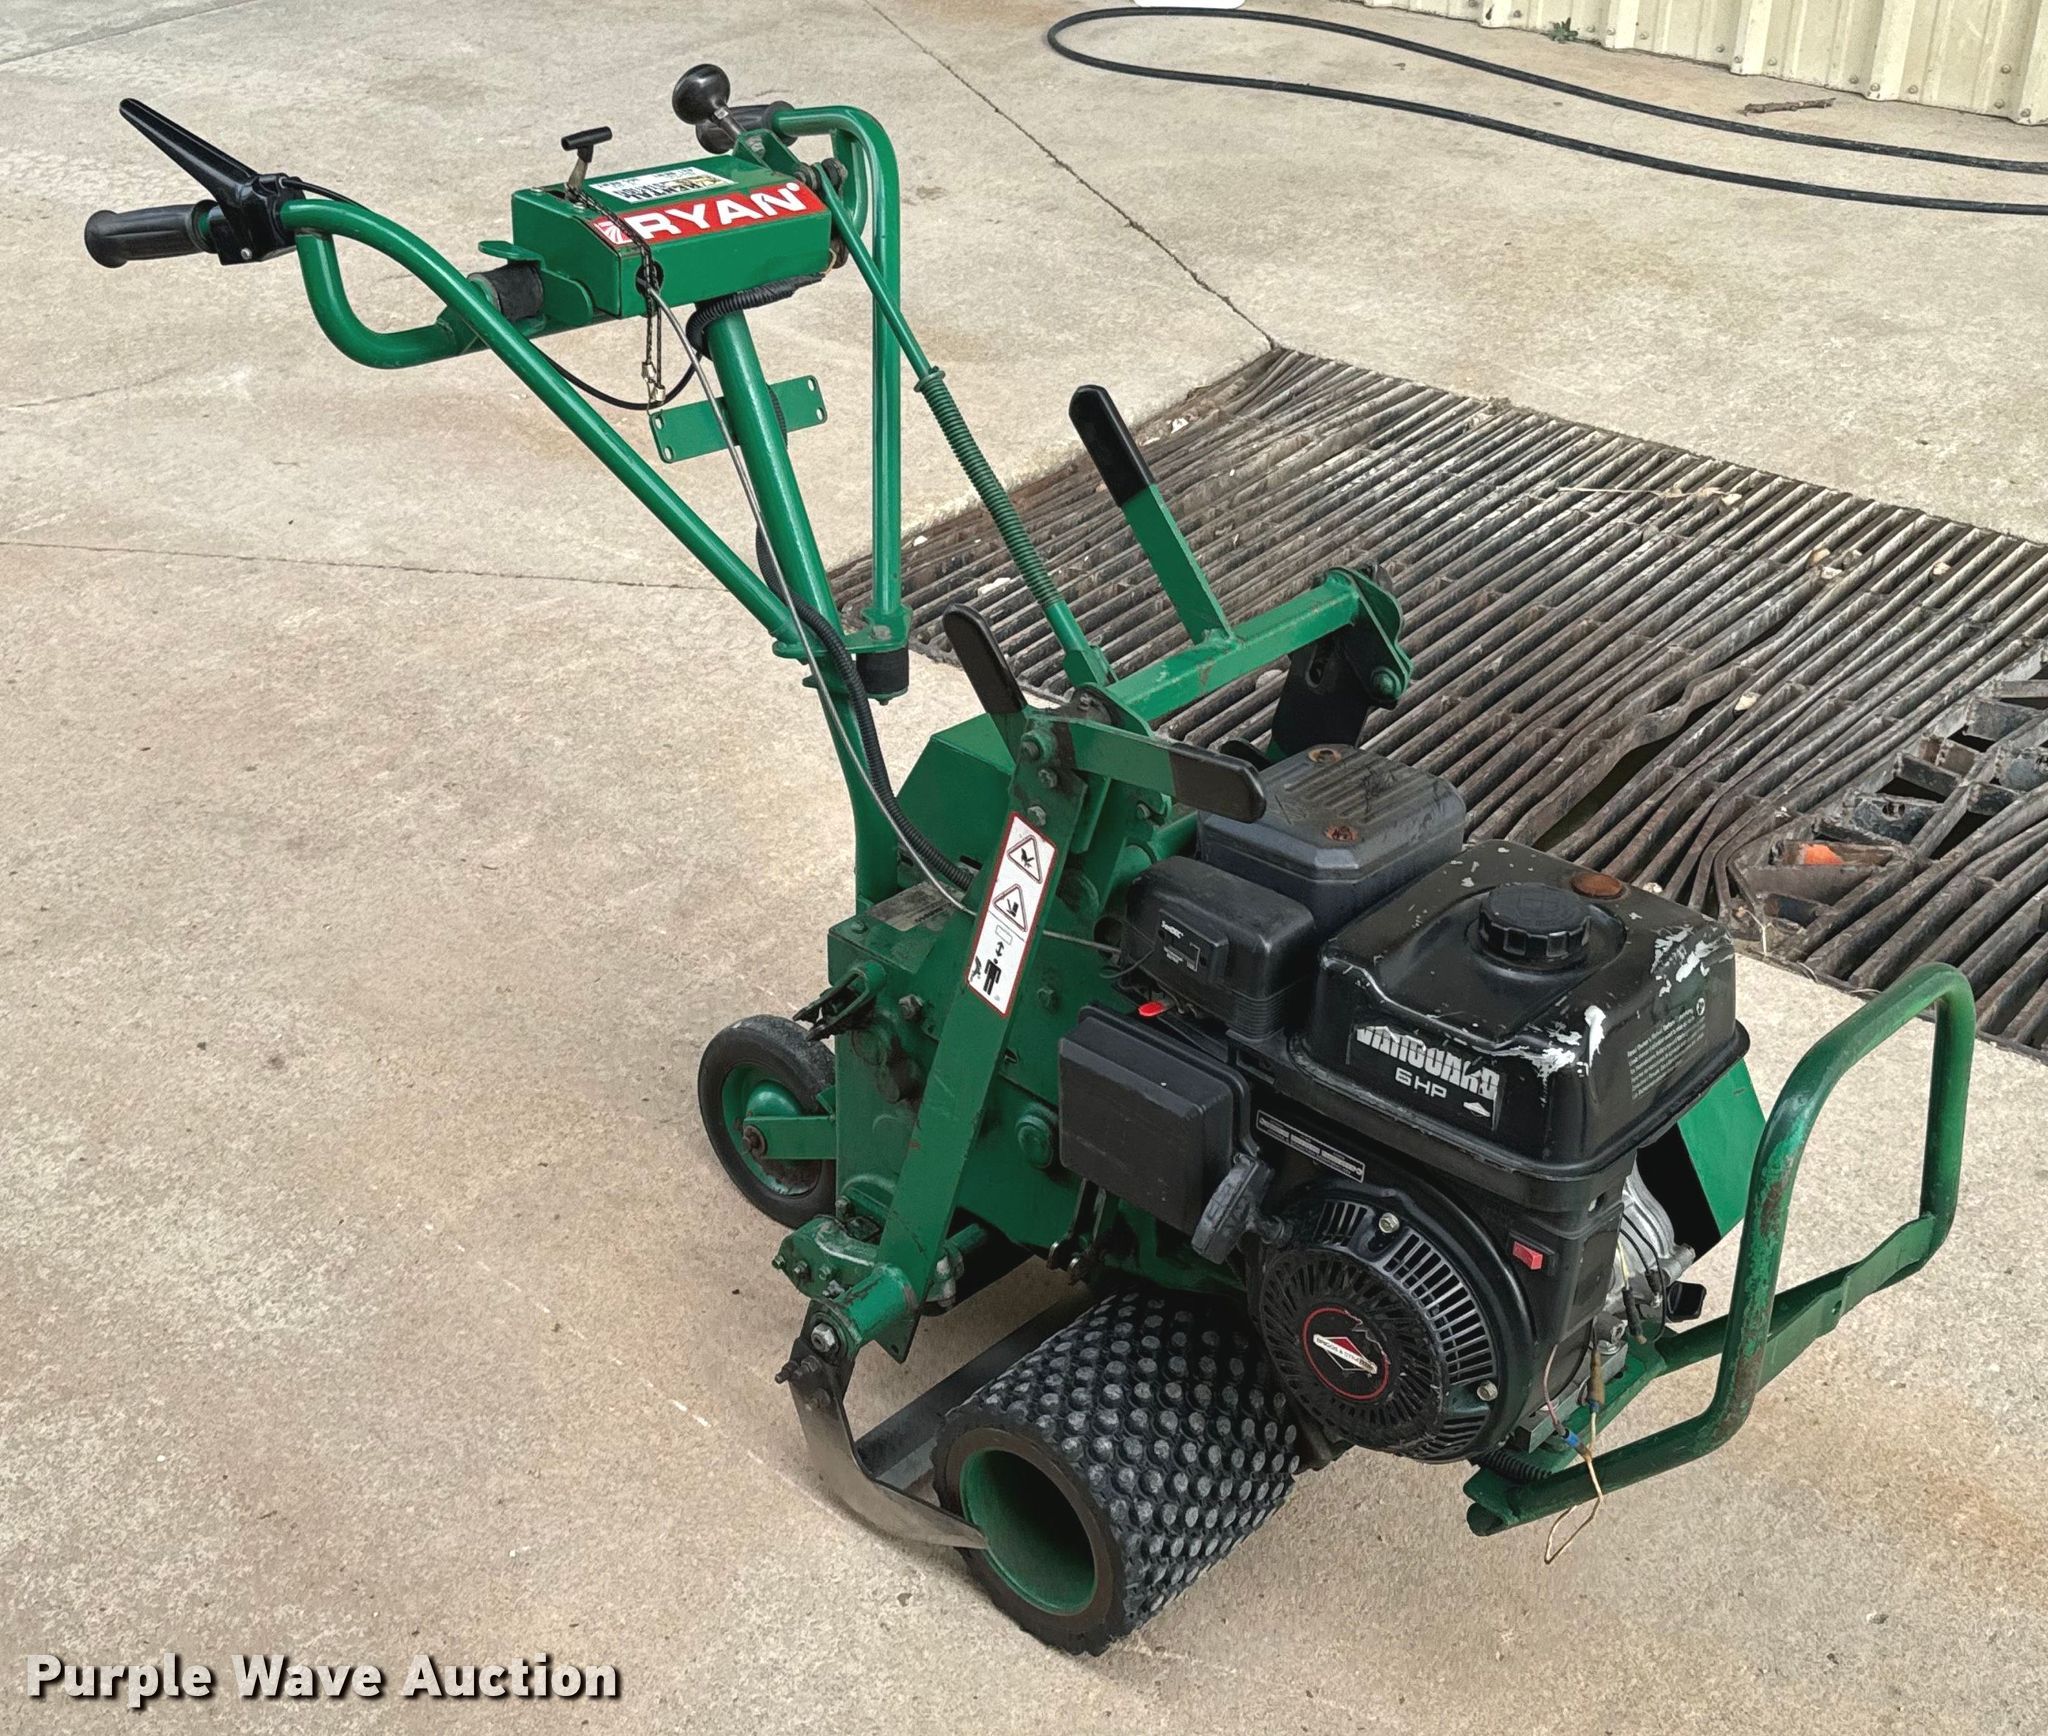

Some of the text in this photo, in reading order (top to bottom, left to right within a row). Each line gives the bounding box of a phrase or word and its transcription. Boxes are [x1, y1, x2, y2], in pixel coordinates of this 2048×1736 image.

[624, 188, 807, 239] RYAN
[1395, 1067, 1447, 1098] 6 HP
